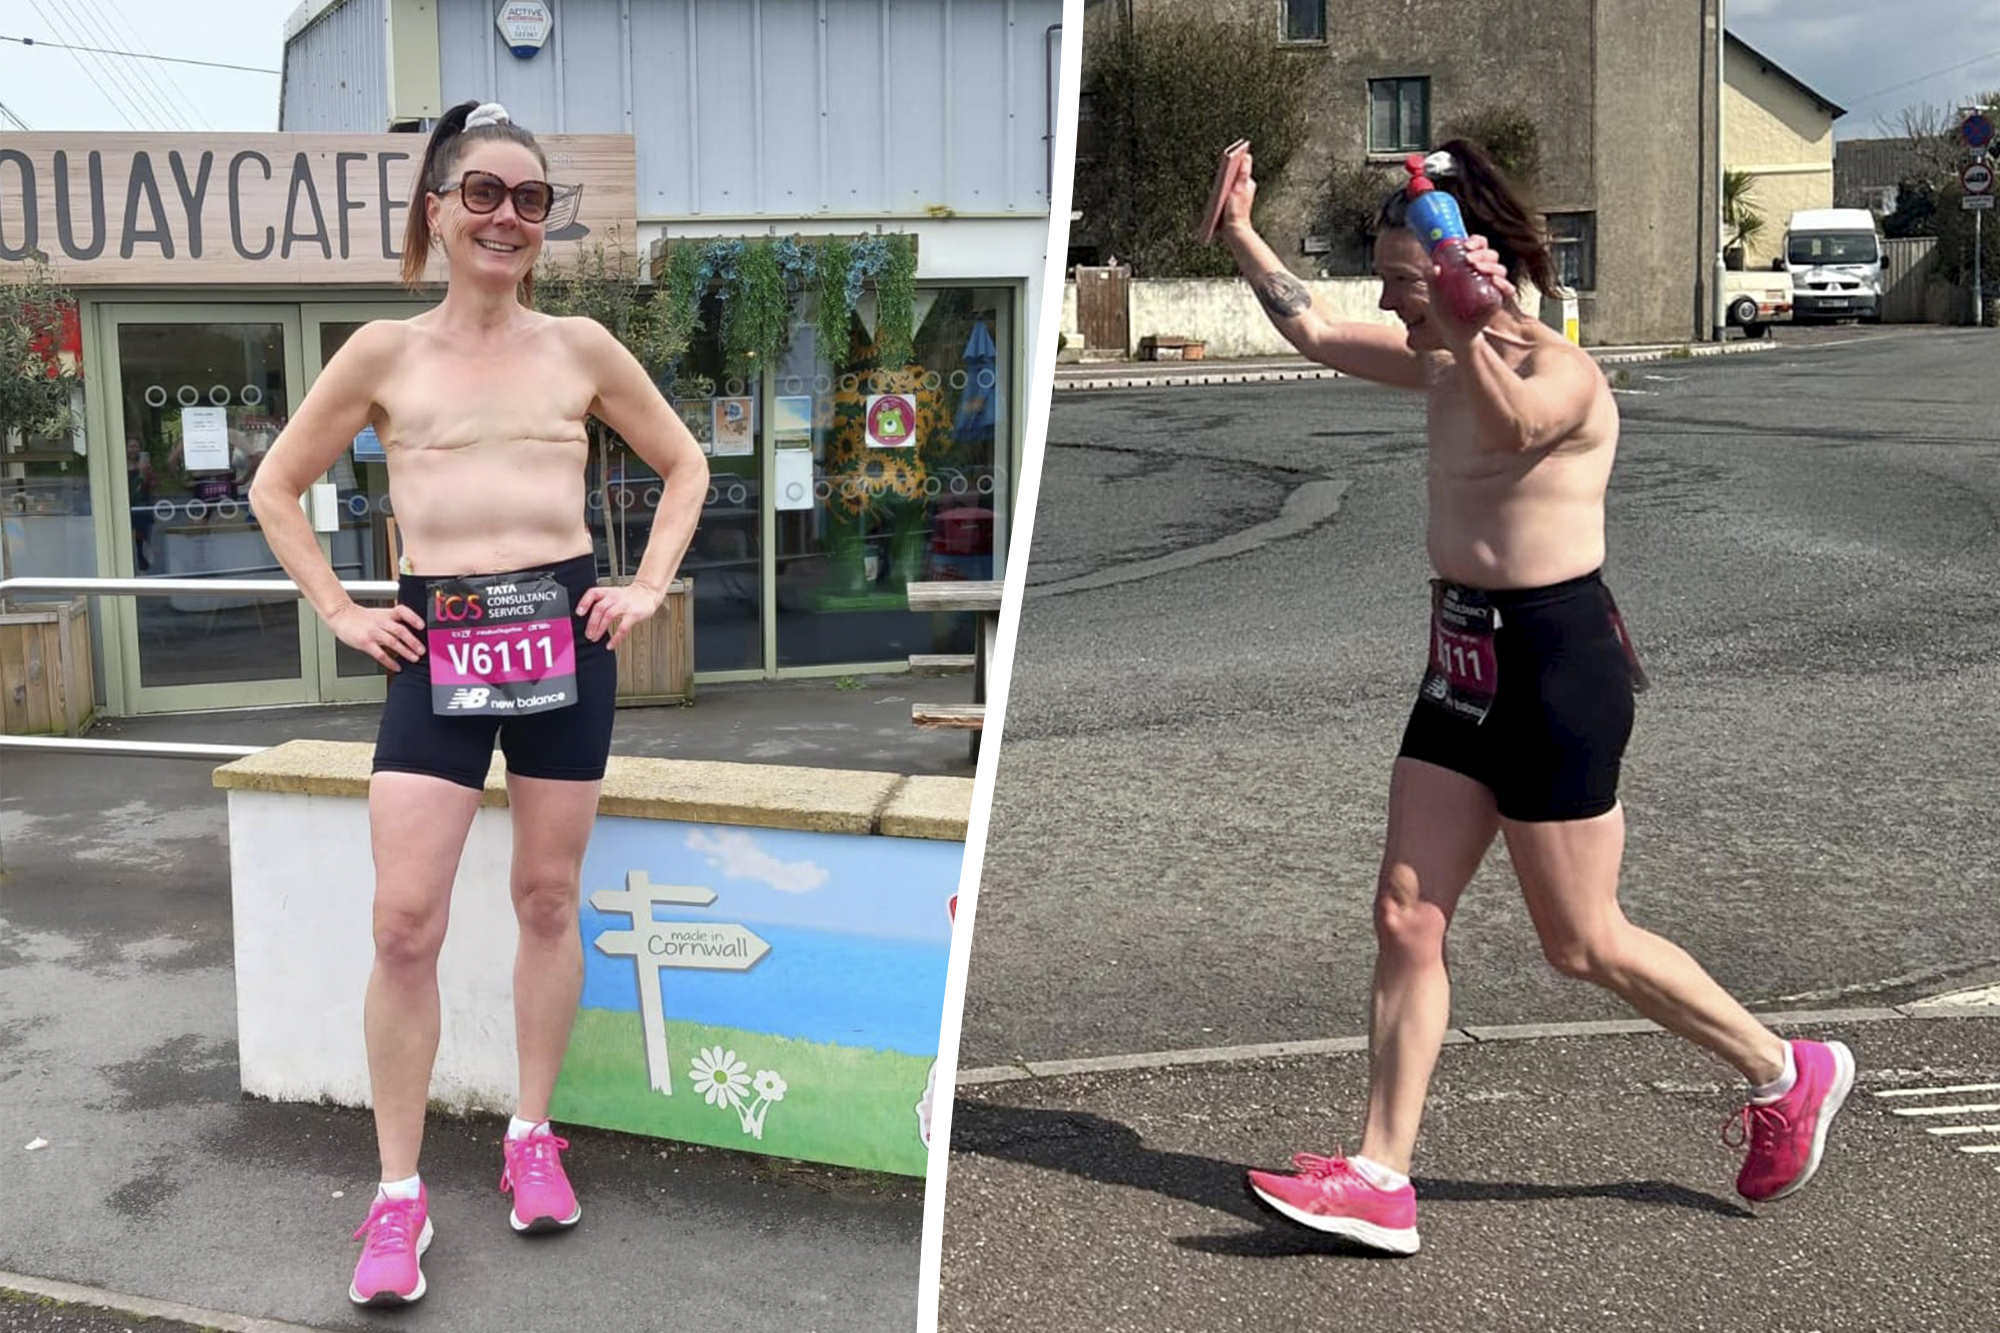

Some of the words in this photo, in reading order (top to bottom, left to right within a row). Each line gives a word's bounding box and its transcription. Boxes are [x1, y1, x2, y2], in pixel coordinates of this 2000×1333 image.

[508, 8, 543, 17] ACTIVE
[485, 584, 517, 596] TATA
[487, 591, 558, 607] CONSULTANCY
[488, 605, 535, 619] SERVICES
[447, 636, 553, 675] V6111
[491, 699, 516, 709] new
[517, 692, 566, 708] balance
[671, 930, 708, 941] made
[711, 930, 725, 941] in
[648, 935, 747, 957] Cornwall
